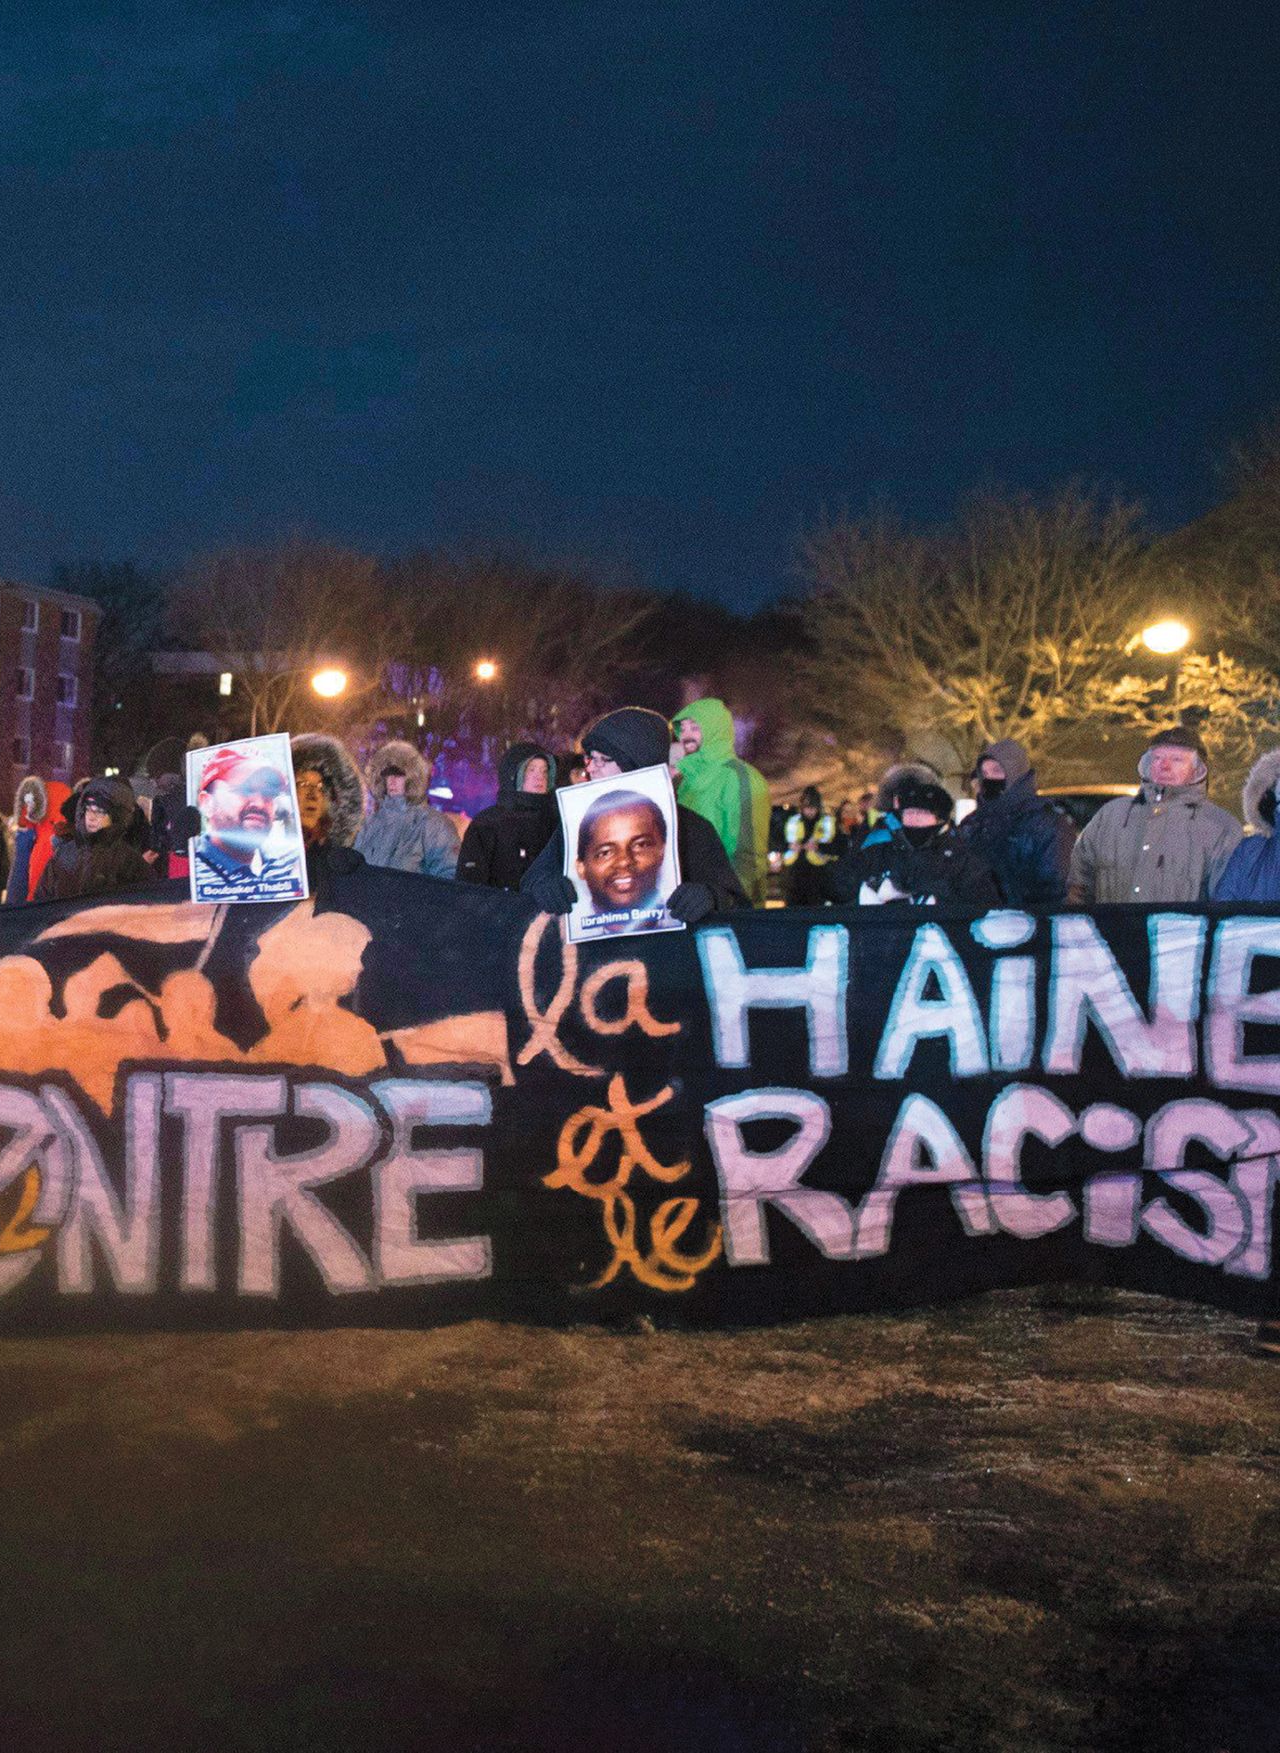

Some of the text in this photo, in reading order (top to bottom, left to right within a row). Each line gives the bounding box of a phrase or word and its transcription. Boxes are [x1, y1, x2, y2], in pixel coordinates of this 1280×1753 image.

[582, 908, 664, 926] Ibrahima Barry
[517, 911, 682, 1077] la
[542, 1071, 692, 1194] et
